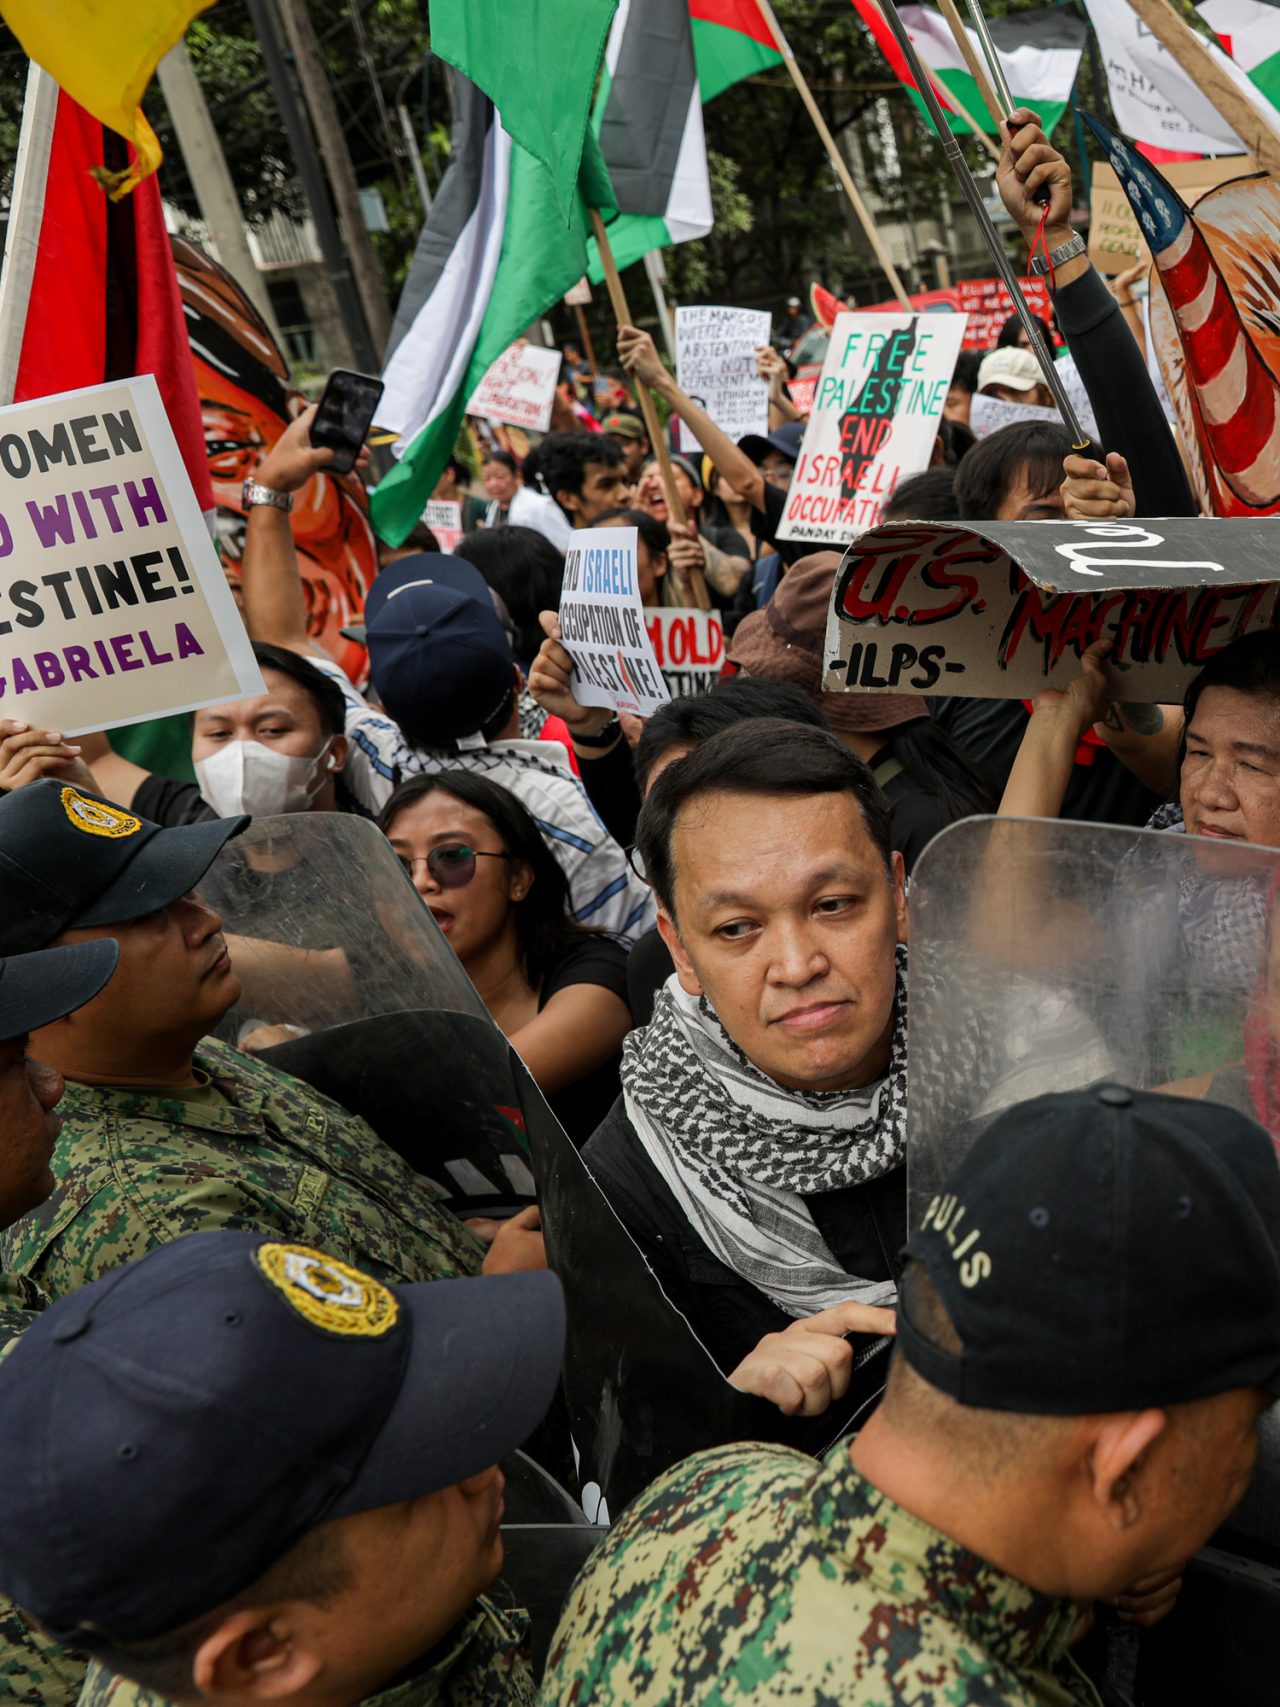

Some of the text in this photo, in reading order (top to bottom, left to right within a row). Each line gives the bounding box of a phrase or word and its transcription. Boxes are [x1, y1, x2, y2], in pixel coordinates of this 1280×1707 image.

[841, 333, 934, 372] FREE
[817, 377, 949, 416] PALESTINE
[839, 415, 893, 456] END
[796, 453, 900, 496] ISRAELI
[25, 477, 168, 549] WITH
[789, 526, 836, 541] PANDAY
[582, 549, 633, 596] ISRAELI
[835, 550, 1003, 627] U.S.
[622, 607, 643, 649] OF
[829, 643, 966, 689] -ILPS-
[920, 1193, 992, 1288] PULIS
